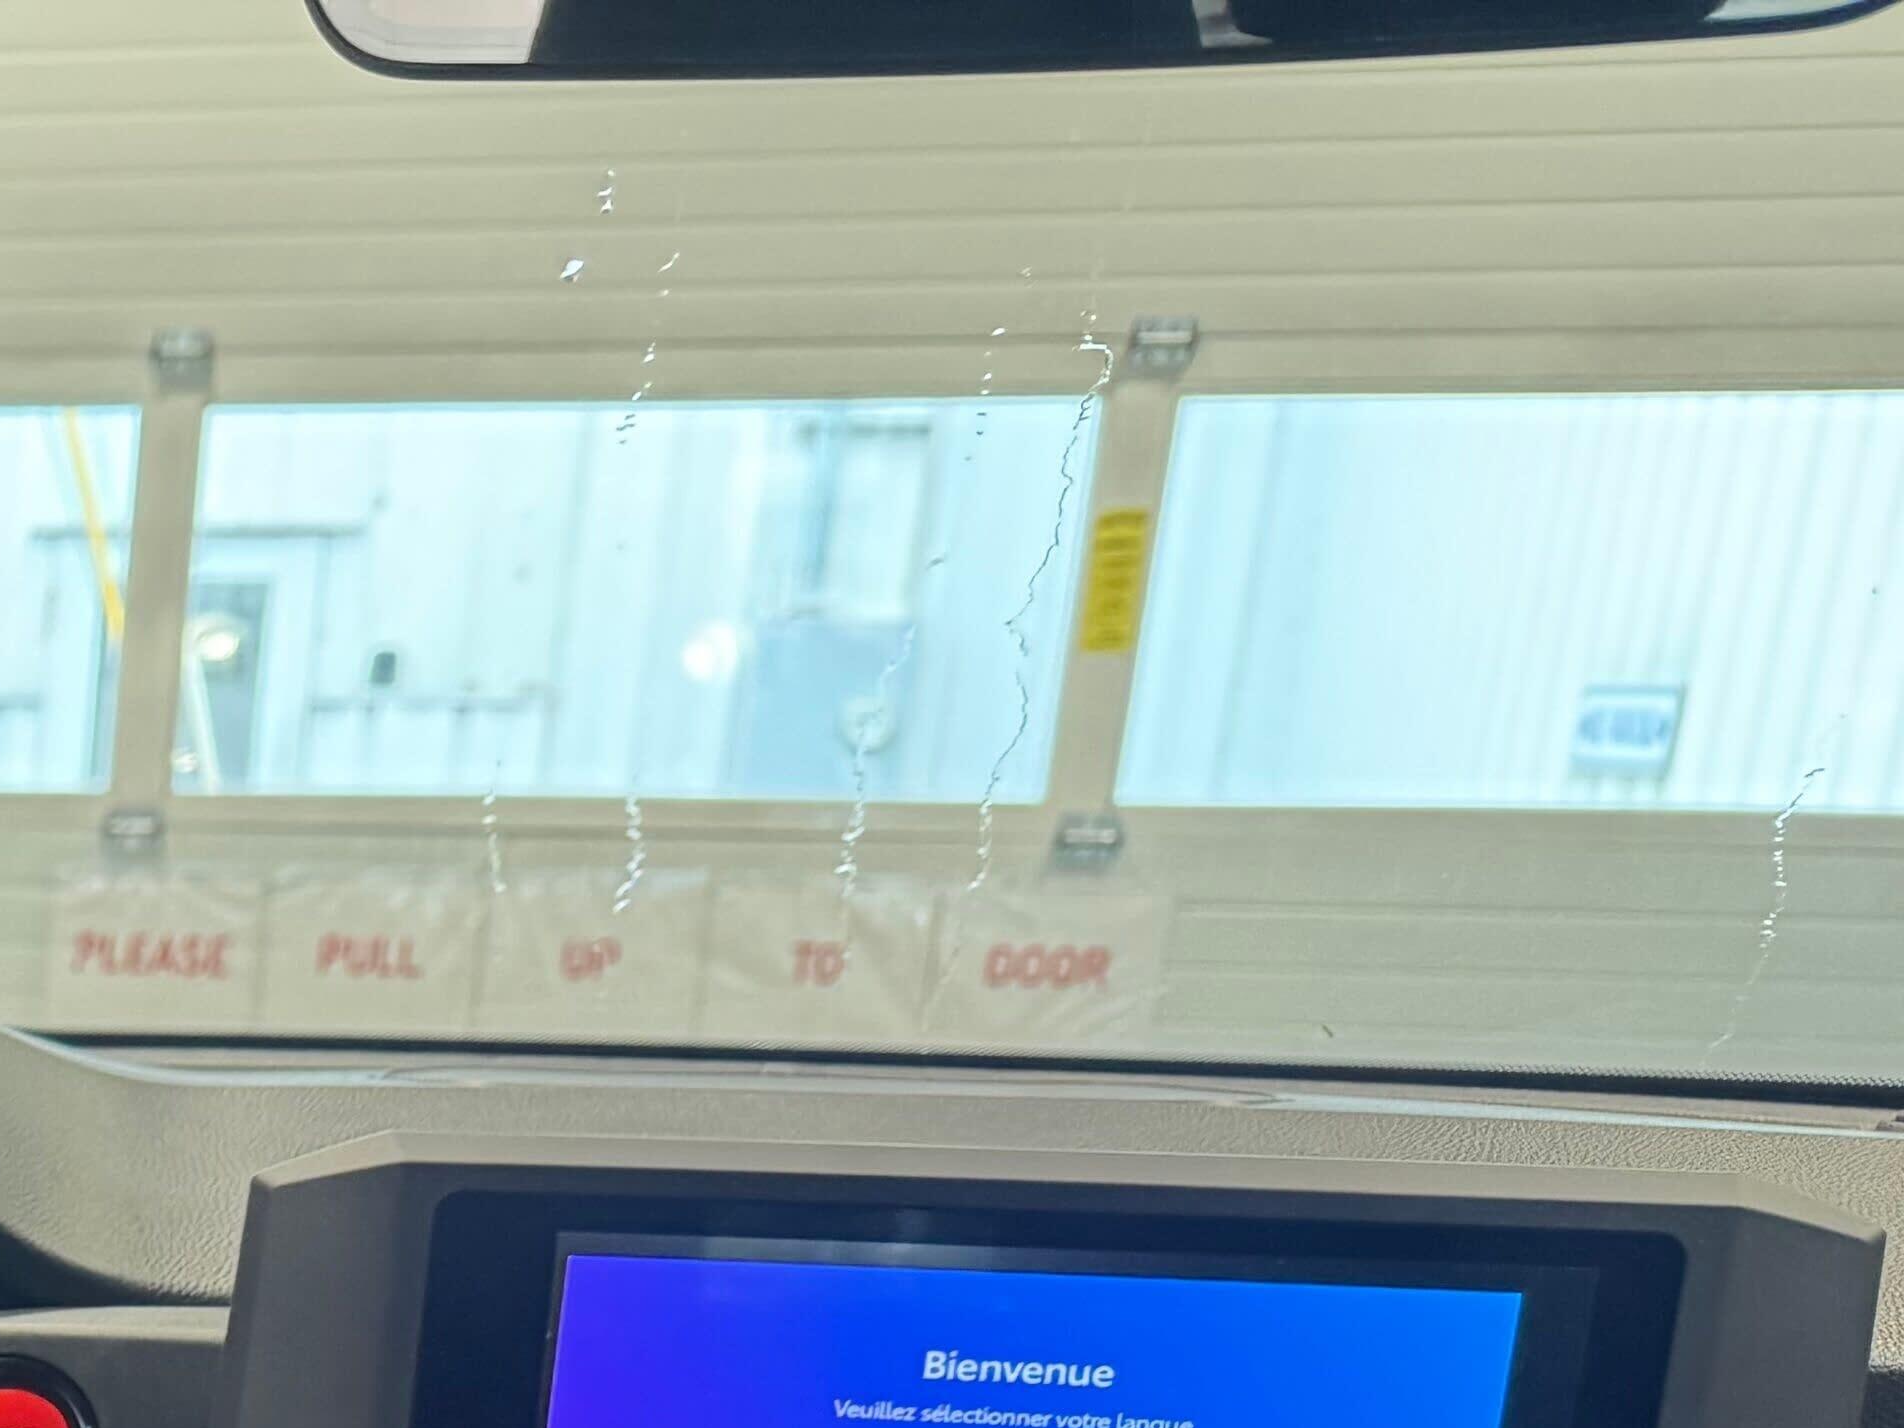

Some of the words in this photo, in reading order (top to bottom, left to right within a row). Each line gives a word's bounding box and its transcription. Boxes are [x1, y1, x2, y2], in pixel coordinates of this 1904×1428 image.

[70, 930, 232, 979] PLEASE
[315, 931, 425, 980] PULL
[559, 935, 623, 982] UP
[793, 939, 848, 987] TO
[983, 942, 1113, 989] DOOR
[922, 1349, 1117, 1388] Bienvenue
[833, 1398, 917, 1422] Veuillez
[920, 1404, 1053, 1428] sélectionner
